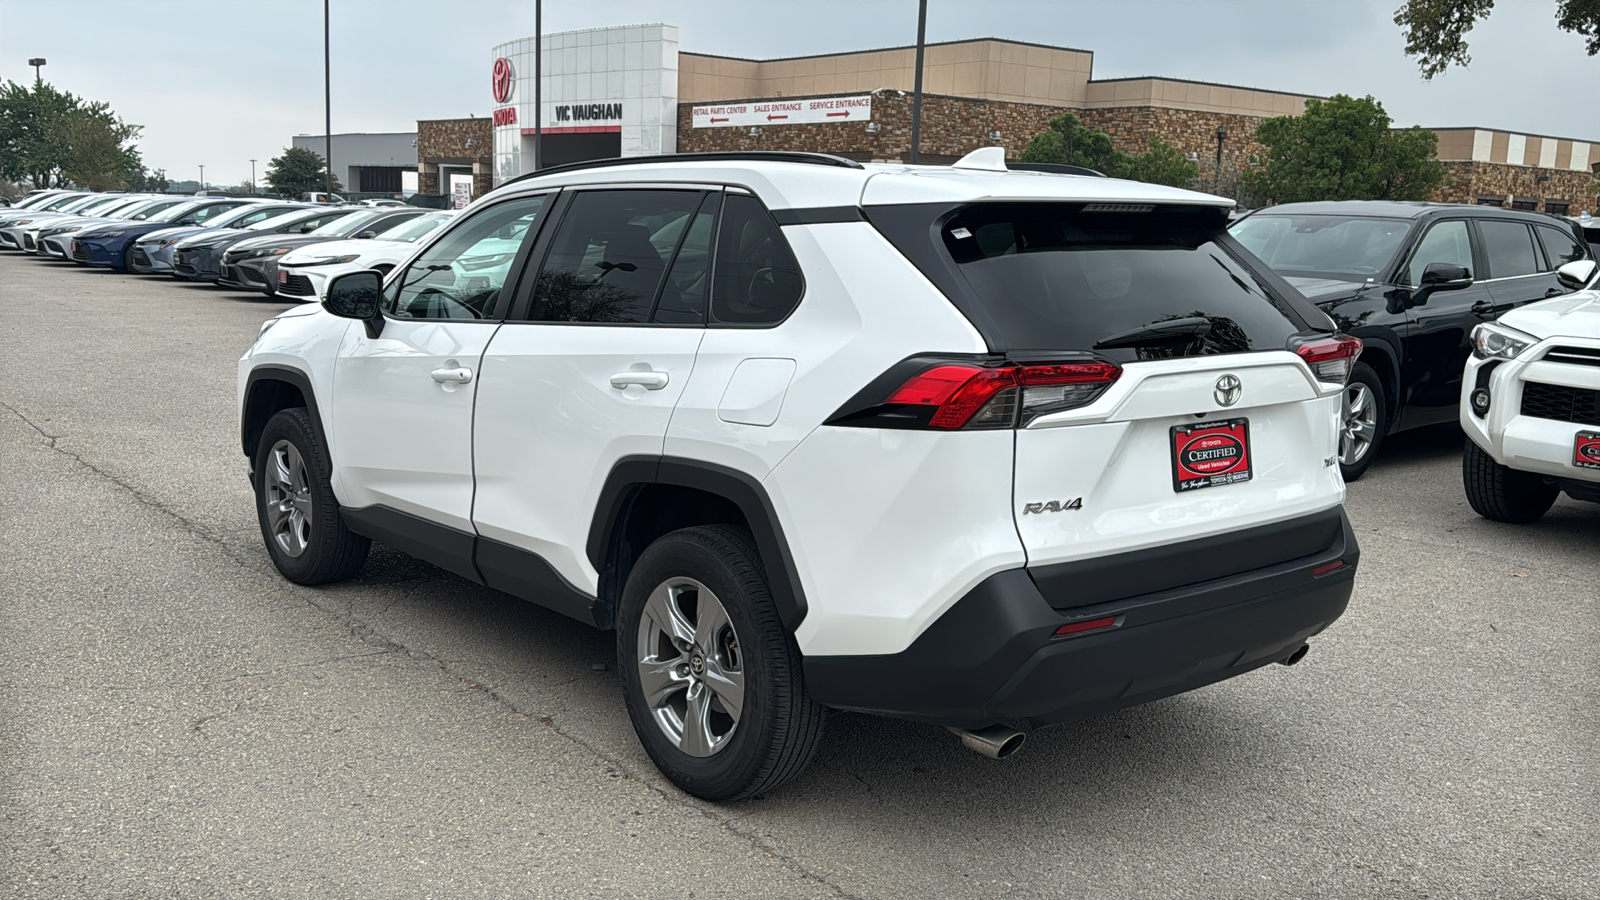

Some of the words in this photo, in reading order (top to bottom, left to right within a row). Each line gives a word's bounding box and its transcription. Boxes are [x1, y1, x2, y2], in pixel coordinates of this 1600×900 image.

[693, 107, 709, 116] RETAIL
[710, 107, 726, 115] PARTS
[727, 106, 747, 114] CENTER
[753, 105, 771, 113] SALES
[771, 103, 802, 112] ENTRANCE
[809, 100, 835, 110] SERVICE
[835, 98, 870, 109] ENTRANCE
[493, 107, 516, 127] TOYOTA
[555, 105, 570, 121] VIC
[572, 103, 623, 121] VAUGHAN
[1189, 447, 1236, 461] CERTIFIED
[1023, 497, 1083, 515] RAV4
